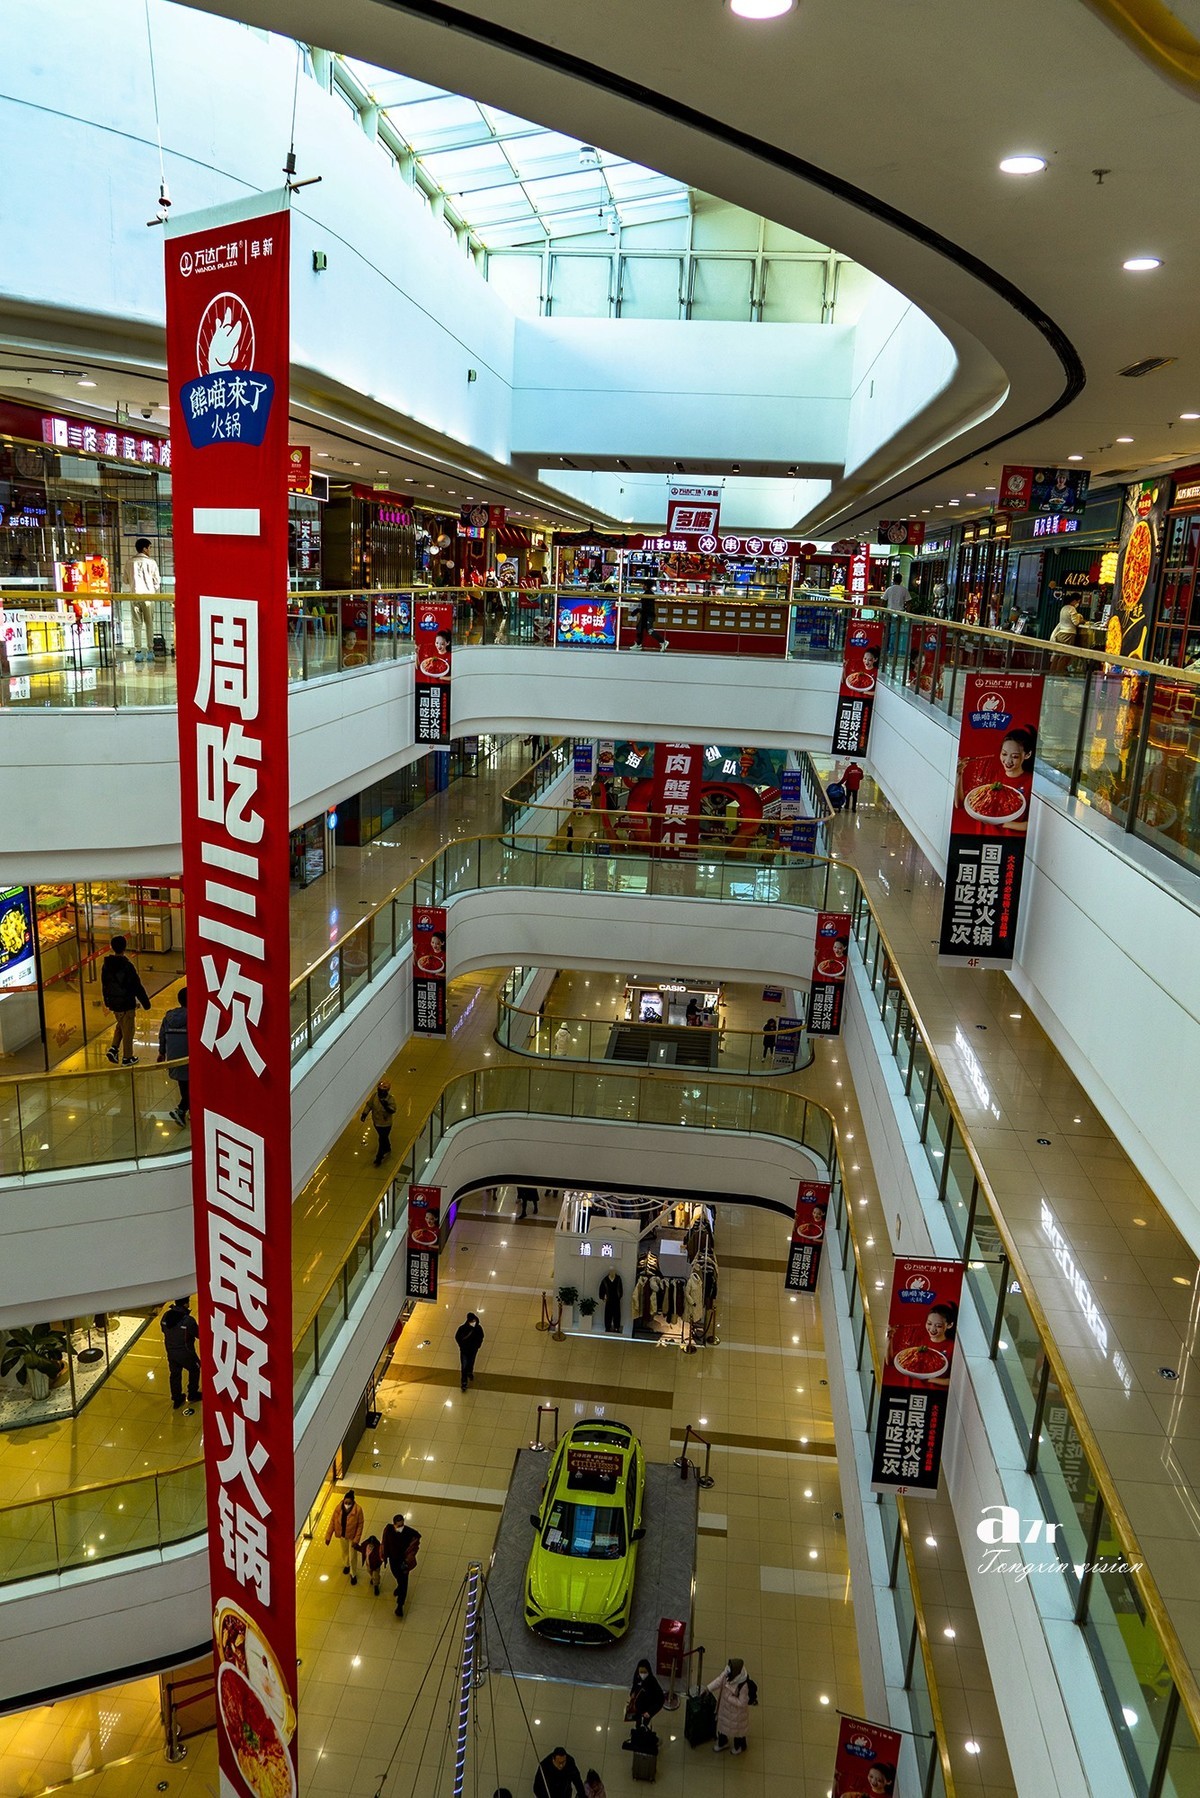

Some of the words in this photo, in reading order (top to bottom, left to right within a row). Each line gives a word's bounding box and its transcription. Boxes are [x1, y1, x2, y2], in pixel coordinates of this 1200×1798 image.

[194, 242, 239, 267] 万达广场
[250, 237, 274, 259] 阜新
[217, 260, 238, 269] PLAZA
[211, 411, 242, 439] 火锅
[1064, 573, 1090, 586] ALPS
[193, 507, 267, 1079] 一周吃三次
[662, 743, 692, 826] 肉蟹煲
[949, 848, 980, 945] 一周吃三次
[972, 843, 1003, 947] 国民好火锅
[658, 984, 687, 993] CASIO
[967, 958, 981, 967] 4F
[203, 1107, 273, 1609] 国民好火锅
[881, 1397, 908, 1477] 一周吃三次
[901, 1394, 928, 1478] 国民好火锅
[897, 1486, 908, 1494] 4F
